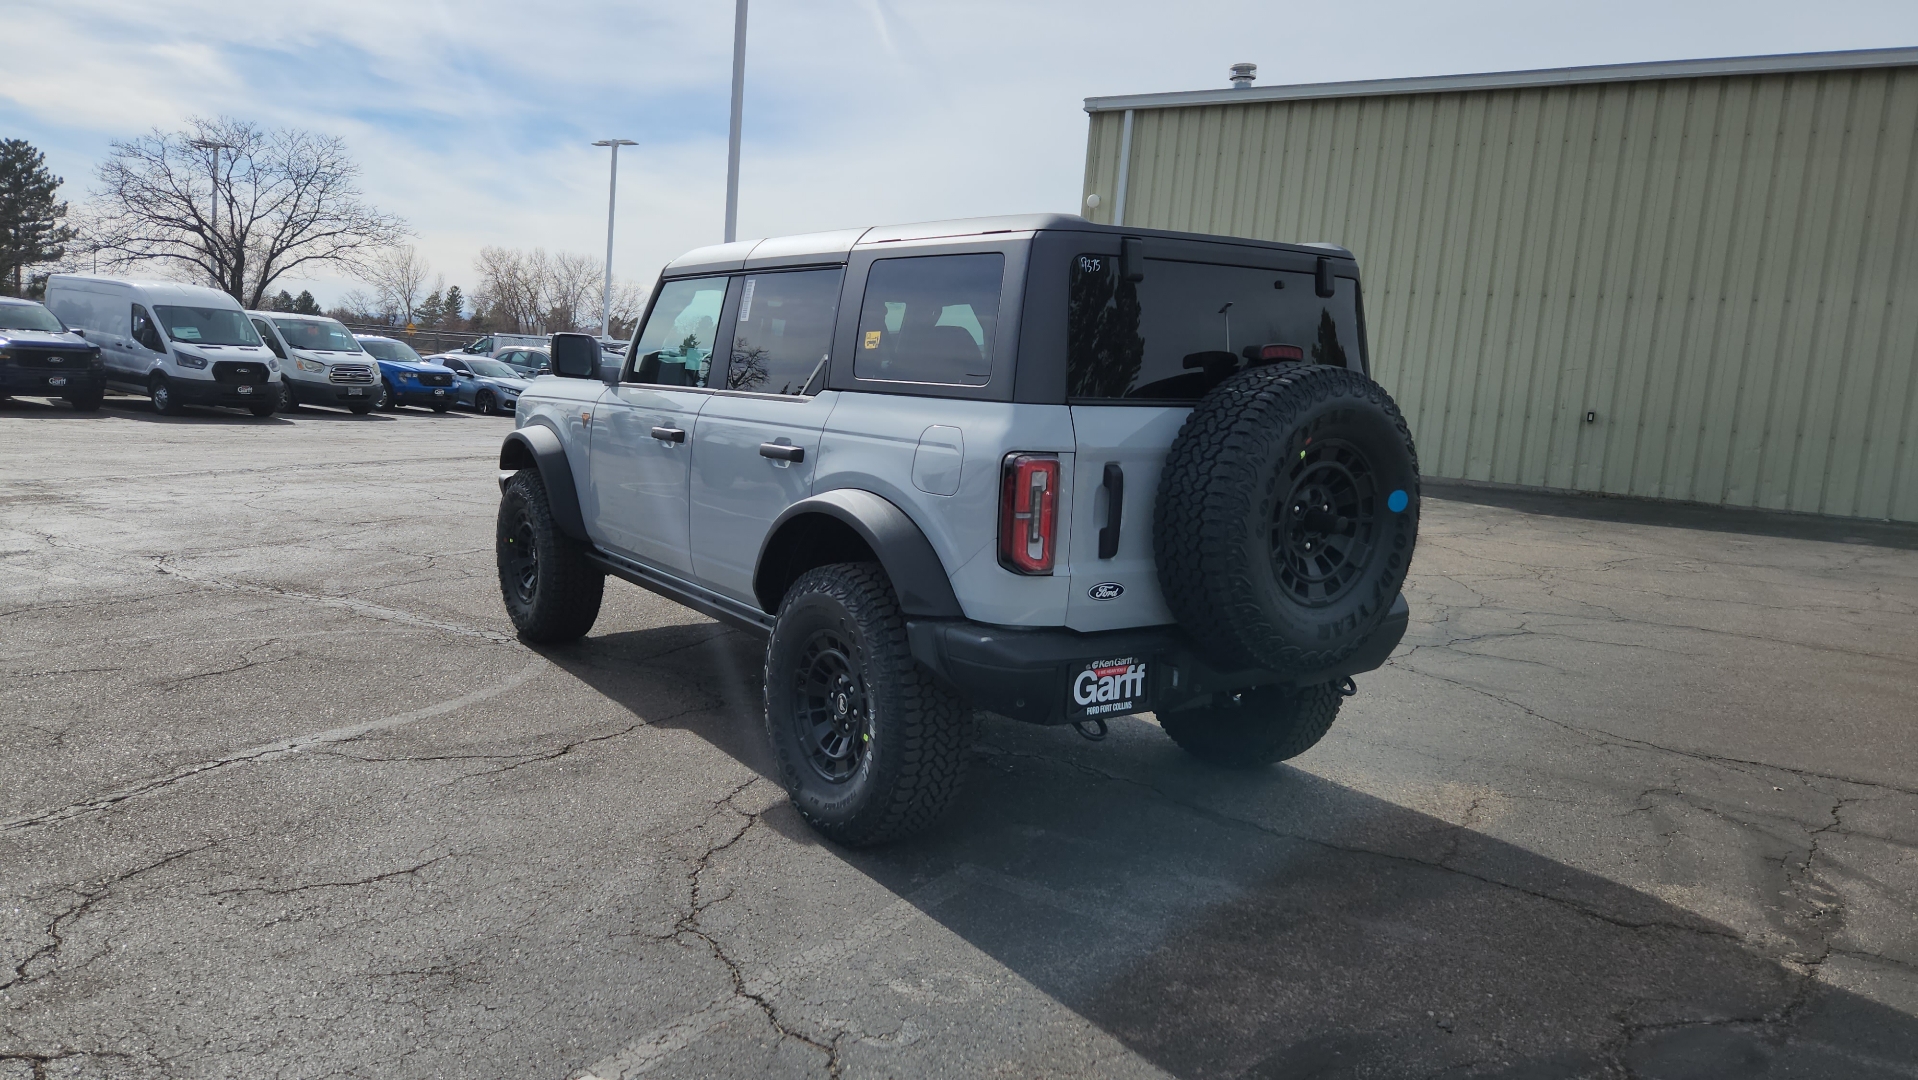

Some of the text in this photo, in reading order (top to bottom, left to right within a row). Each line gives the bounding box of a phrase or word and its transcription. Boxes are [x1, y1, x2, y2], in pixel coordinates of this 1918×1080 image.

[1095, 585, 1119, 598] Ford
[1099, 657, 1133, 668] Ken Garff
[1073, 663, 1146, 706] Garff
[1086, 701, 1133, 716] FORD FORT COLLINS
